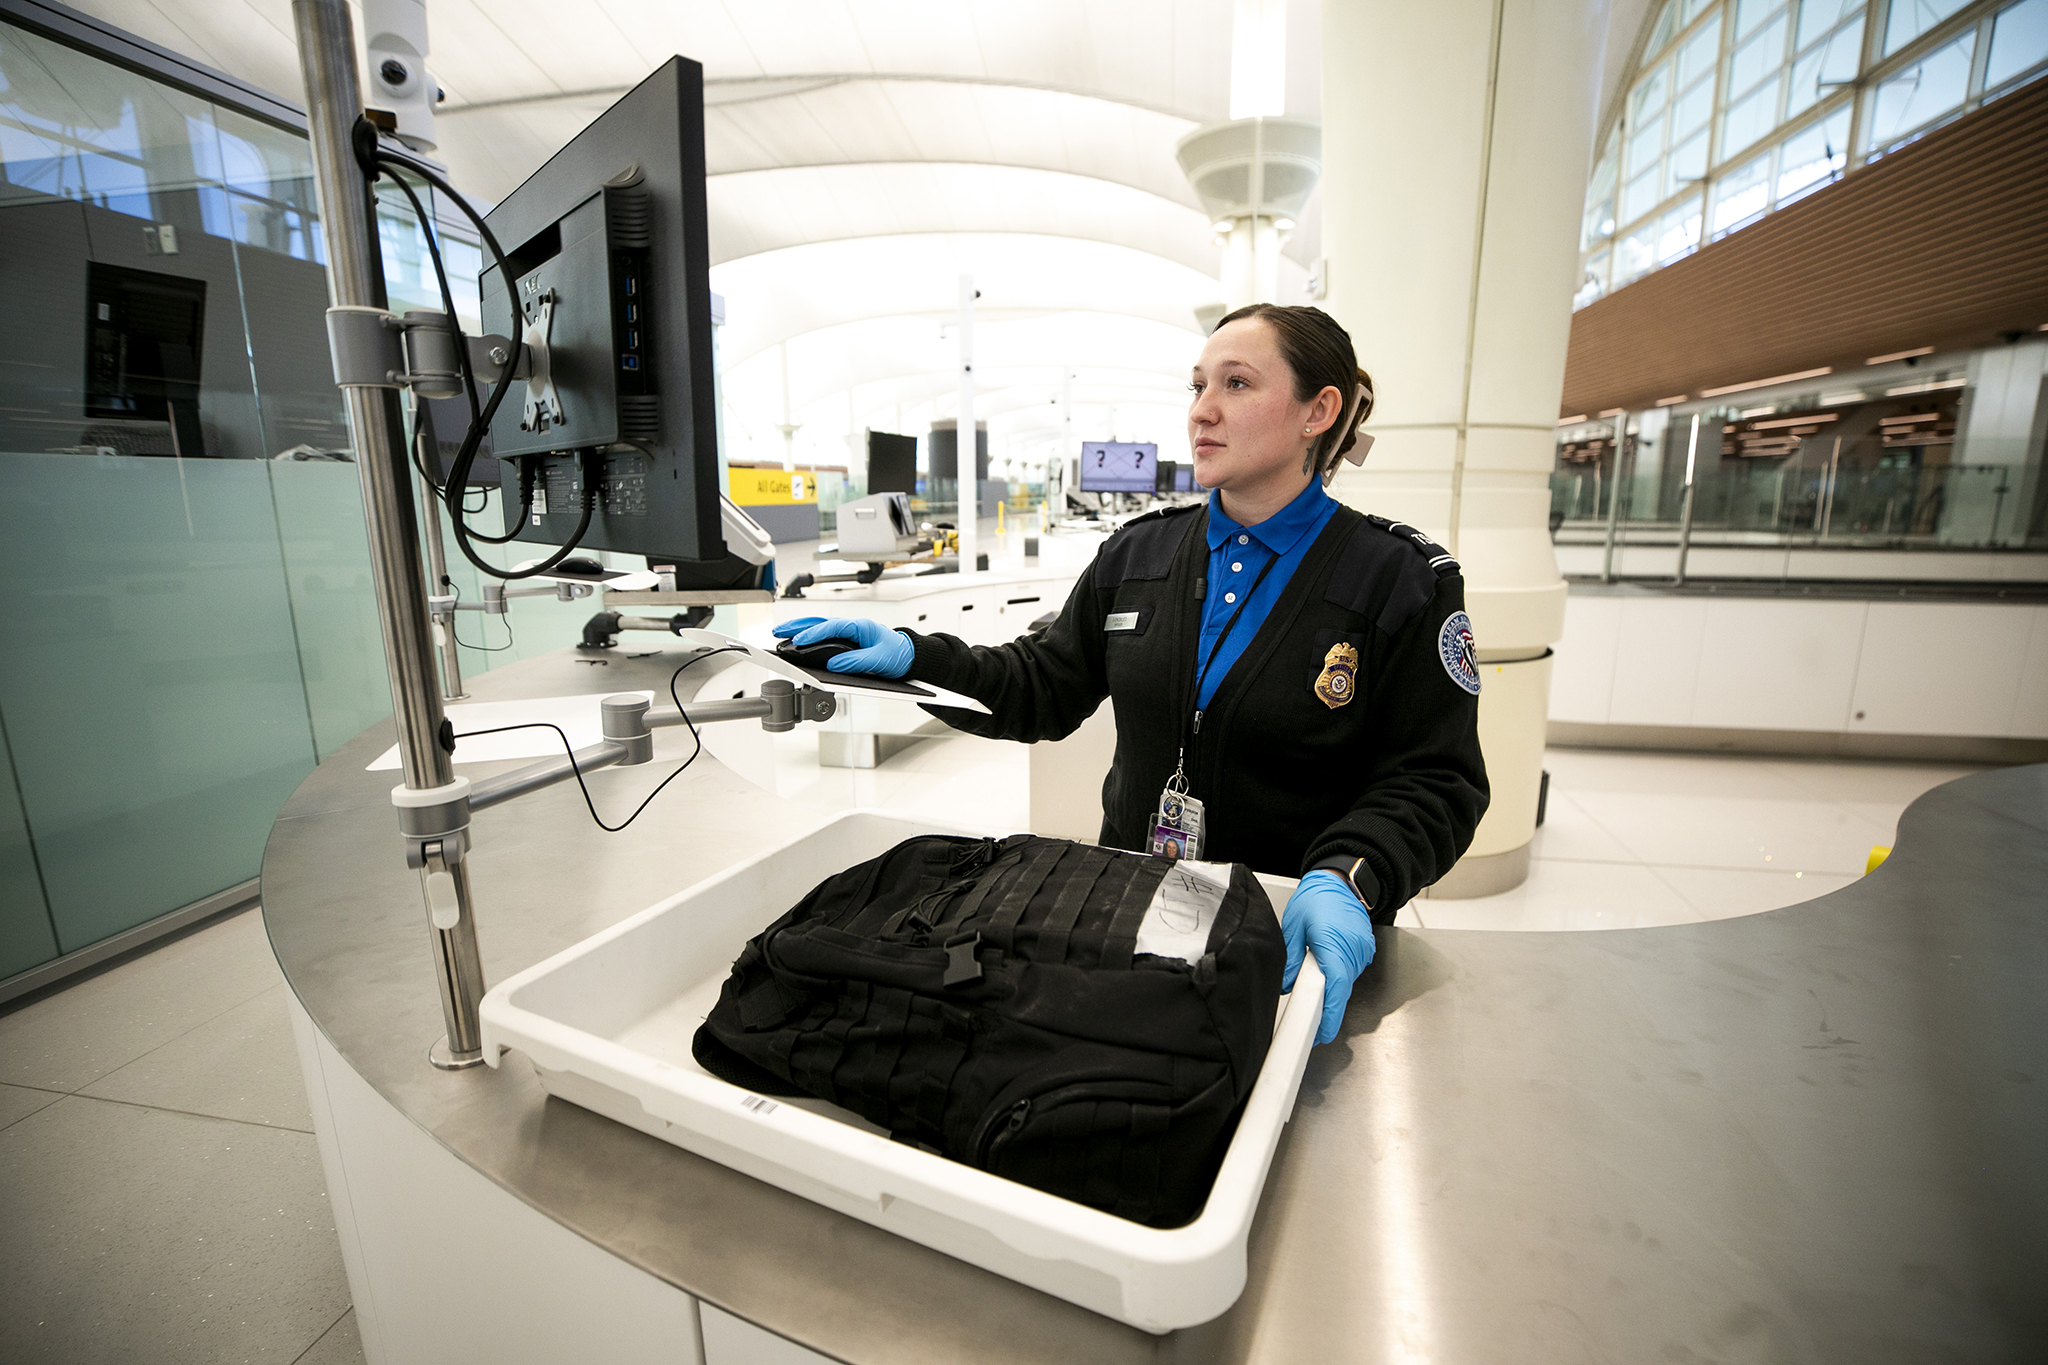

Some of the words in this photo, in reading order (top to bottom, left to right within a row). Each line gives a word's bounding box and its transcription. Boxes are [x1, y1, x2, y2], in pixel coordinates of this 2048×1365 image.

[524, 272, 542, 297] NEC
[1096, 450, 1105, 468] ?
[1134, 451, 1144, 469] ?
[757, 480, 768, 493] All
[770, 480, 791, 493] Gates
[1445, 617, 1460, 636] TEAM
